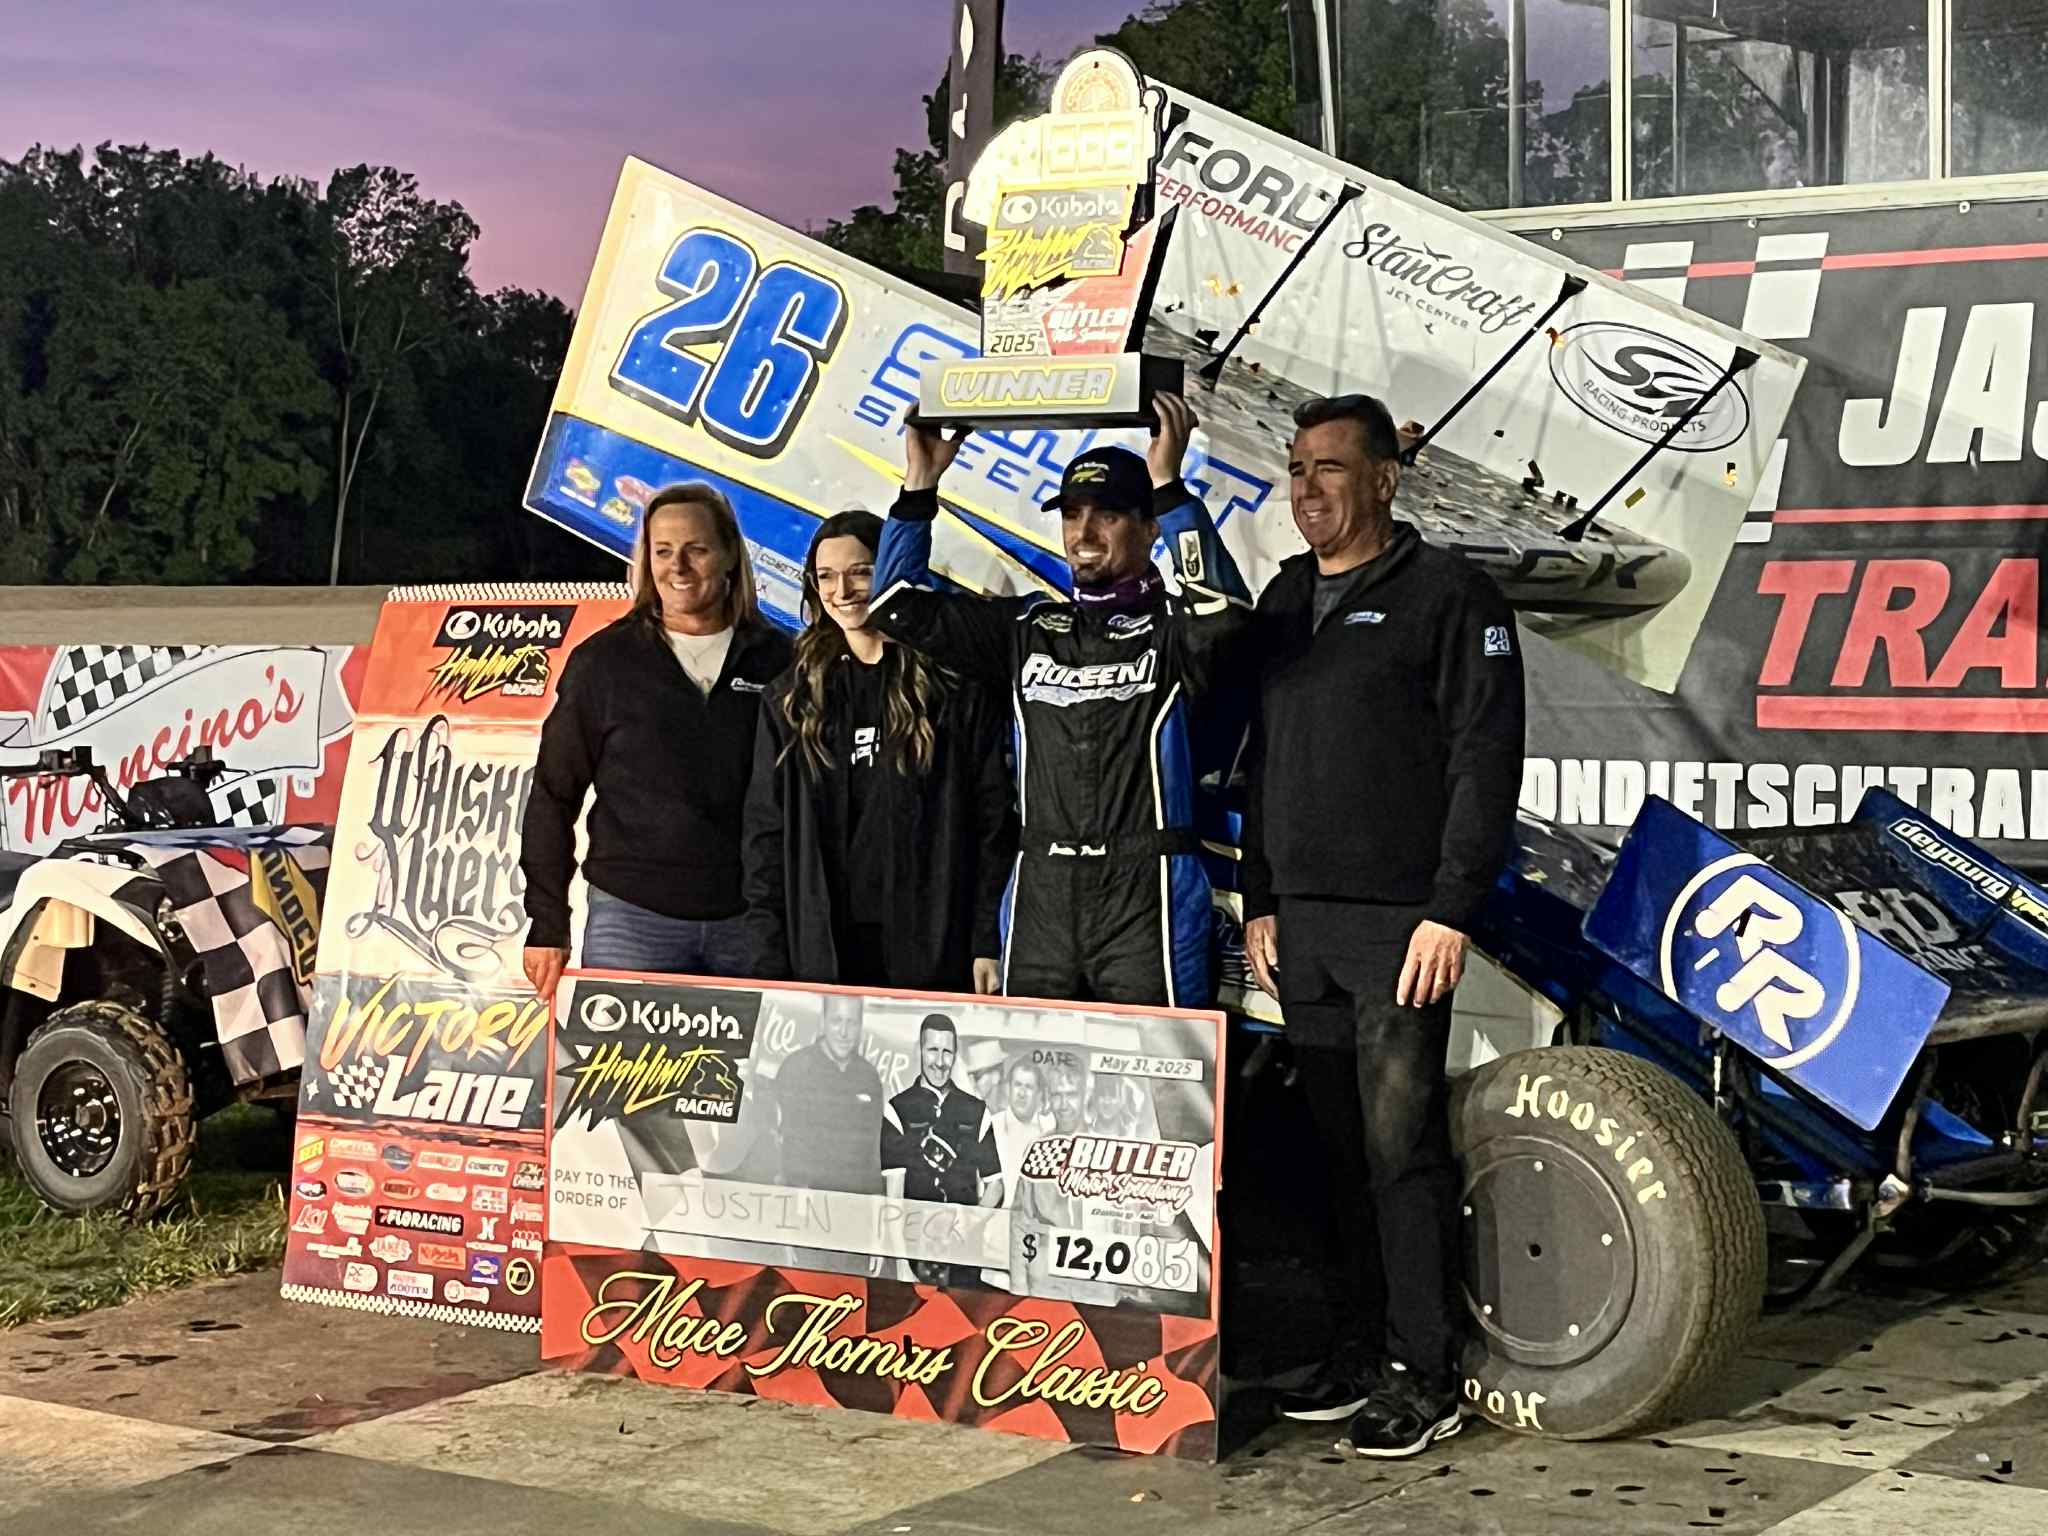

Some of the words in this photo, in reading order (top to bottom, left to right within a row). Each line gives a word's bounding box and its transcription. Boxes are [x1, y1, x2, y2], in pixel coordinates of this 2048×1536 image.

[1040, 193, 1122, 218] Kubota
[1161, 131, 1336, 232] FORD
[1155, 172, 1304, 254] PERFORMANC
[1343, 223, 1536, 334] StanCraft
[1386, 286, 1412, 303] JET
[1415, 298, 1469, 329] CENTER
[610, 228, 847, 456] 26
[990, 333, 1036, 353] 2025
[942, 366, 1114, 404] WINNER
[1583, 379, 1628, 420] RACING
[1631, 414, 1707, 434] PRODCTS
[1837, 303, 2048, 466] JA
[482, 612, 562, 639] Kubota
[1757, 558, 2048, 687] TRA
[632, 1000, 744, 1040] Kubota
[1100, 1055, 1129, 1073] May
[1155, 1061, 1193, 1075] 2025
[674, 1098, 735, 1118] RACING
[1068, 1136, 1196, 1180] BUTLER
[1504, 1074, 1668, 1204] Hoosier
[554, 1169, 583, 1184] PAY
[584, 1172, 605, 1187] TO
[608, 1174, 637, 1190] THE
[554, 1190, 604, 1208] ORDER
[608, 1194, 628, 1211] OF
[657, 1182, 832, 1234] JUSTIN
[875, 1203, 966, 1246] PECK
[1022, 1233, 1038, 1263] $
[1055, 1234, 1192, 1288] 12,085
[581, 1271, 748, 1369] Mace
[744, 1293, 955, 1384] Thomas
[971, 1317, 1170, 1415] Classic
[1464, 1378, 1547, 1431] Hoo
